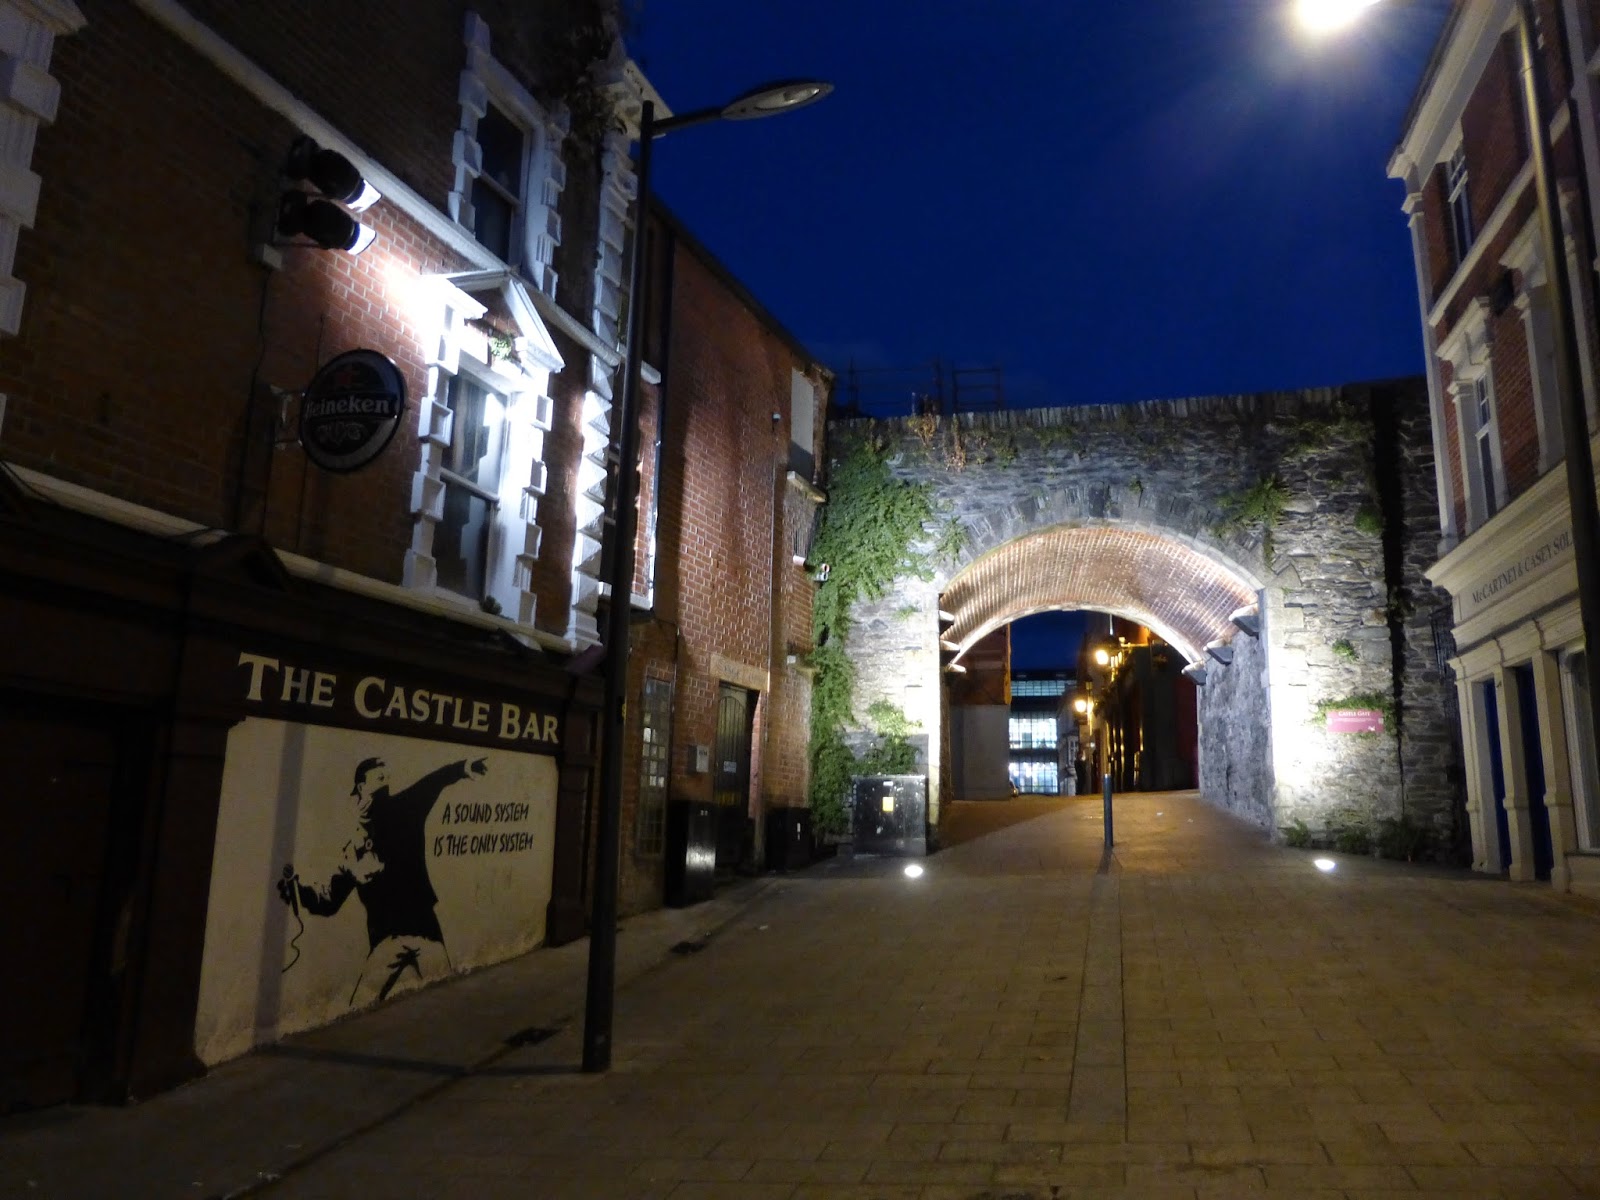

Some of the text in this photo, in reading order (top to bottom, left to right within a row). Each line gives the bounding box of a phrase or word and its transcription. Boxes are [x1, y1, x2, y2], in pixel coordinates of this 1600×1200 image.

[1524, 543, 1552, 572] CASEY
[238, 652, 559, 744] THE CASTLE BAR
[442, 803, 530, 825] A SOUND SYSTEM
[433, 832, 534, 857] IS THE ONLY SYSTEM
